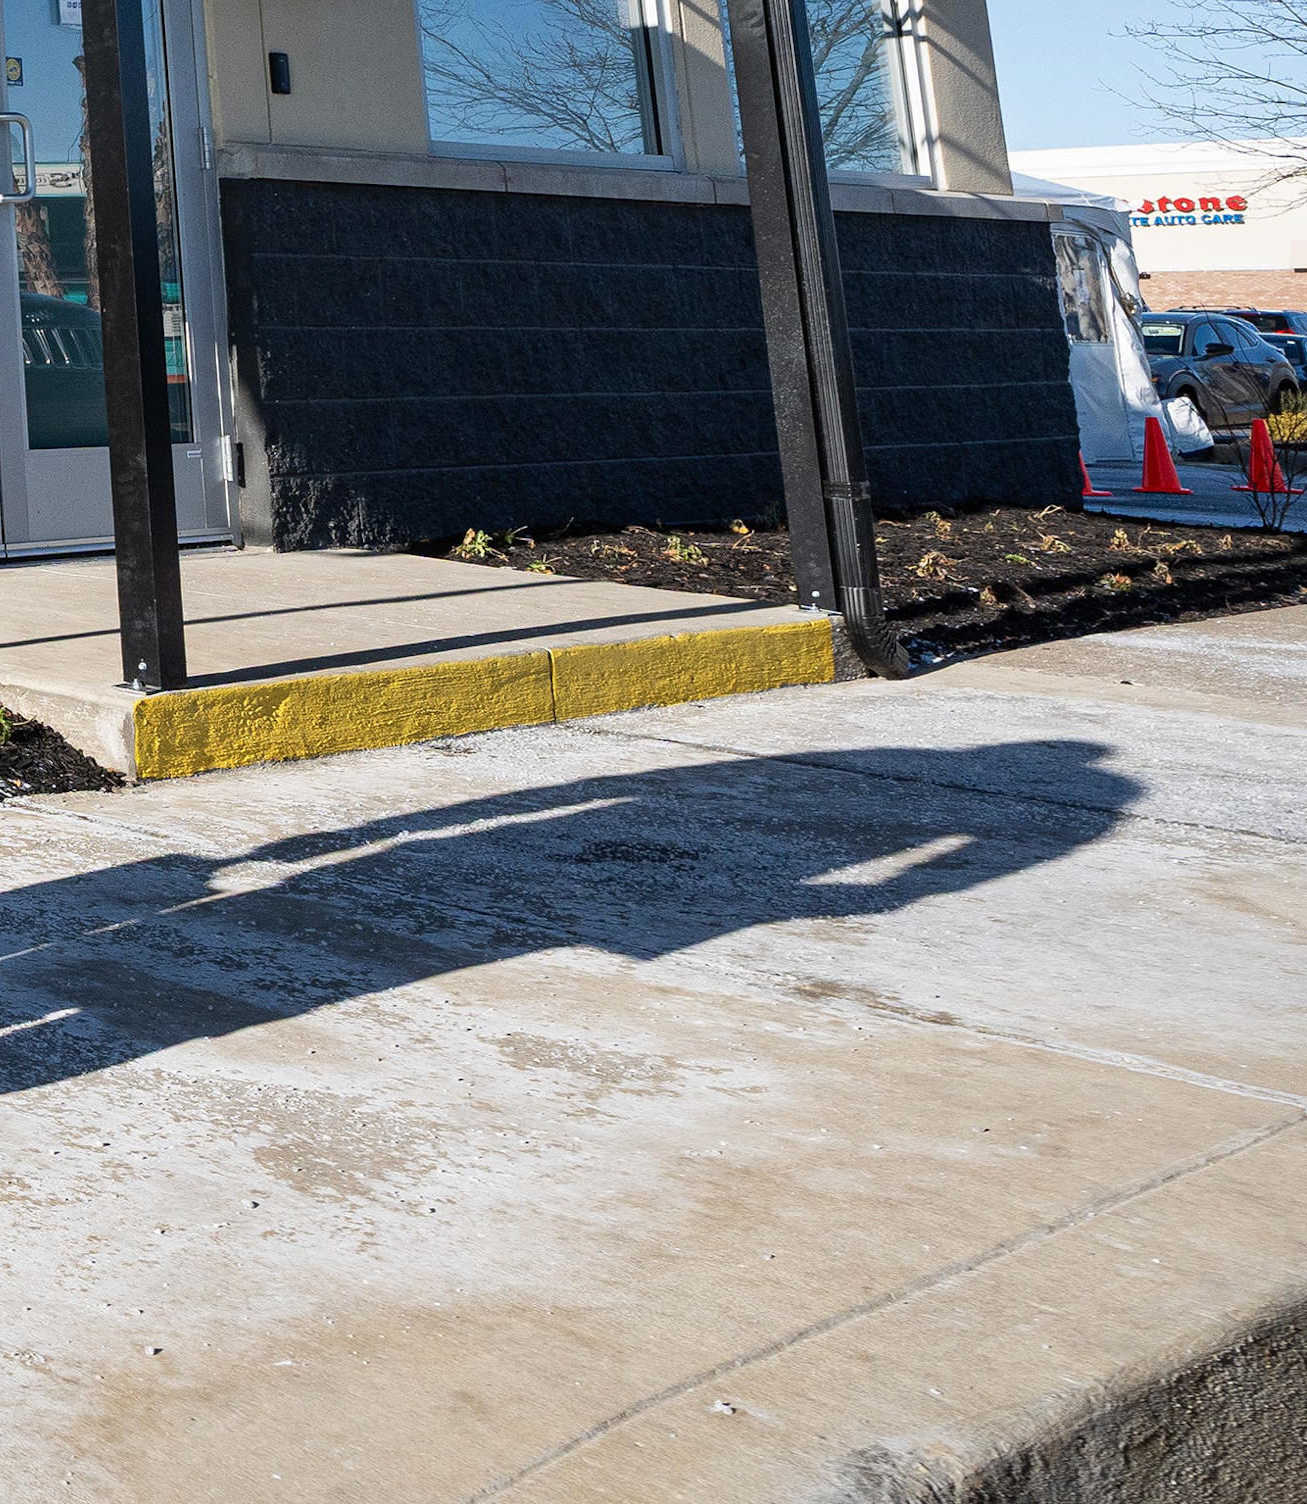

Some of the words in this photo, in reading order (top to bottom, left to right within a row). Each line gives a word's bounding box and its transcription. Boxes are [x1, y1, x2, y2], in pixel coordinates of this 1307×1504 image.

[1137, 195, 1248, 214] stone
[1154, 215, 1197, 226] AUTO
[1201, 213, 1245, 225] CARE
